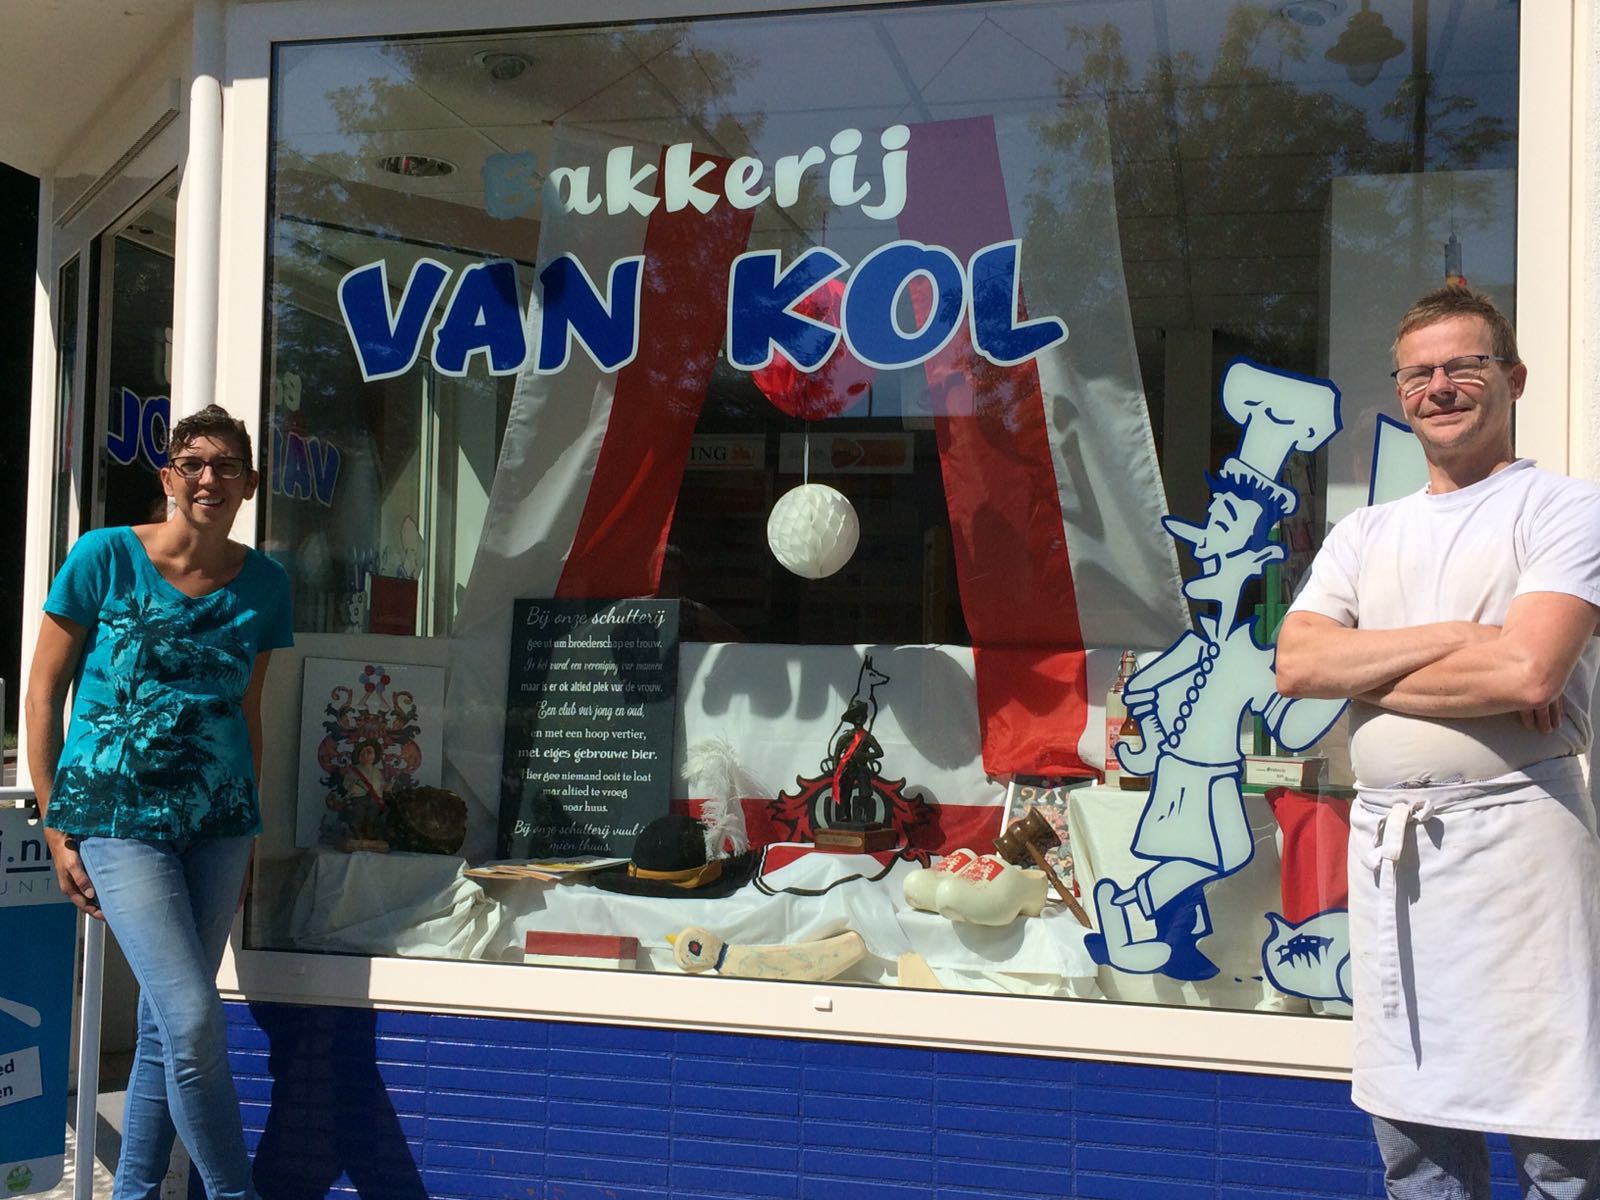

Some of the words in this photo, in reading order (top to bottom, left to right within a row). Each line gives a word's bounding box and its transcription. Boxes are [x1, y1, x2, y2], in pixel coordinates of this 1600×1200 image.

[482, 122, 911, 220] Bakkerij
[337, 252, 646, 382] VAN
[727, 239, 1070, 372] KOL
[527, 606, 549, 629] Bij
[554, 613, 587, 628] onze
[592, 607, 665, 629] schutterij
[554, 640, 567, 648] um
[568, 635, 623, 650] broederschap
[637, 639, 663, 648] trouw.
[571, 662, 582, 670] een
[584, 660, 618, 675] vereniging
[521, 683, 539, 692] maar
[549, 684, 558, 692] er
[559, 681, 568, 692] ok
[571, 681, 591, 692] altied
[593, 682, 608, 693] plek
[611, 684, 623, 692] vur
[625, 682, 635, 692] de
[637, 684, 663, 692] vrouw.
[536, 700, 556, 719] Een
[558, 702, 576, 716] club
[578, 705, 592, 716] vur
[593, 705, 613, 720] jong
[615, 707, 625, 716] en
[627, 703, 645, 718] oud,
[545, 729, 563, 737] met
[585, 728, 609, 740] hoop
[611, 729, 647, 740] vertier,
[518, 748, 540, 758] met
[544, 748, 570, 763] eiges
[574, 748, 628, 763] gebrouwe
[632, 749, 657, 760] bier.
[543, 771, 560, 782] gee
[562, 770, 601, 780] niemand
[603, 771, 620, 781] ooit
[623, 772, 632, 781] te
[633, 769, 651, 781] loat
[562, 785, 589, 796] altied
[591, 787, 600, 796] te
[602, 789, 628, 799] vroeg
[584, 801, 608, 812] huus.
[514, 820, 531, 836] Bij
[533, 825, 555, 837] onze
[560, 821, 610, 839] schutterij
[612, 823, 639, 836] vuul
